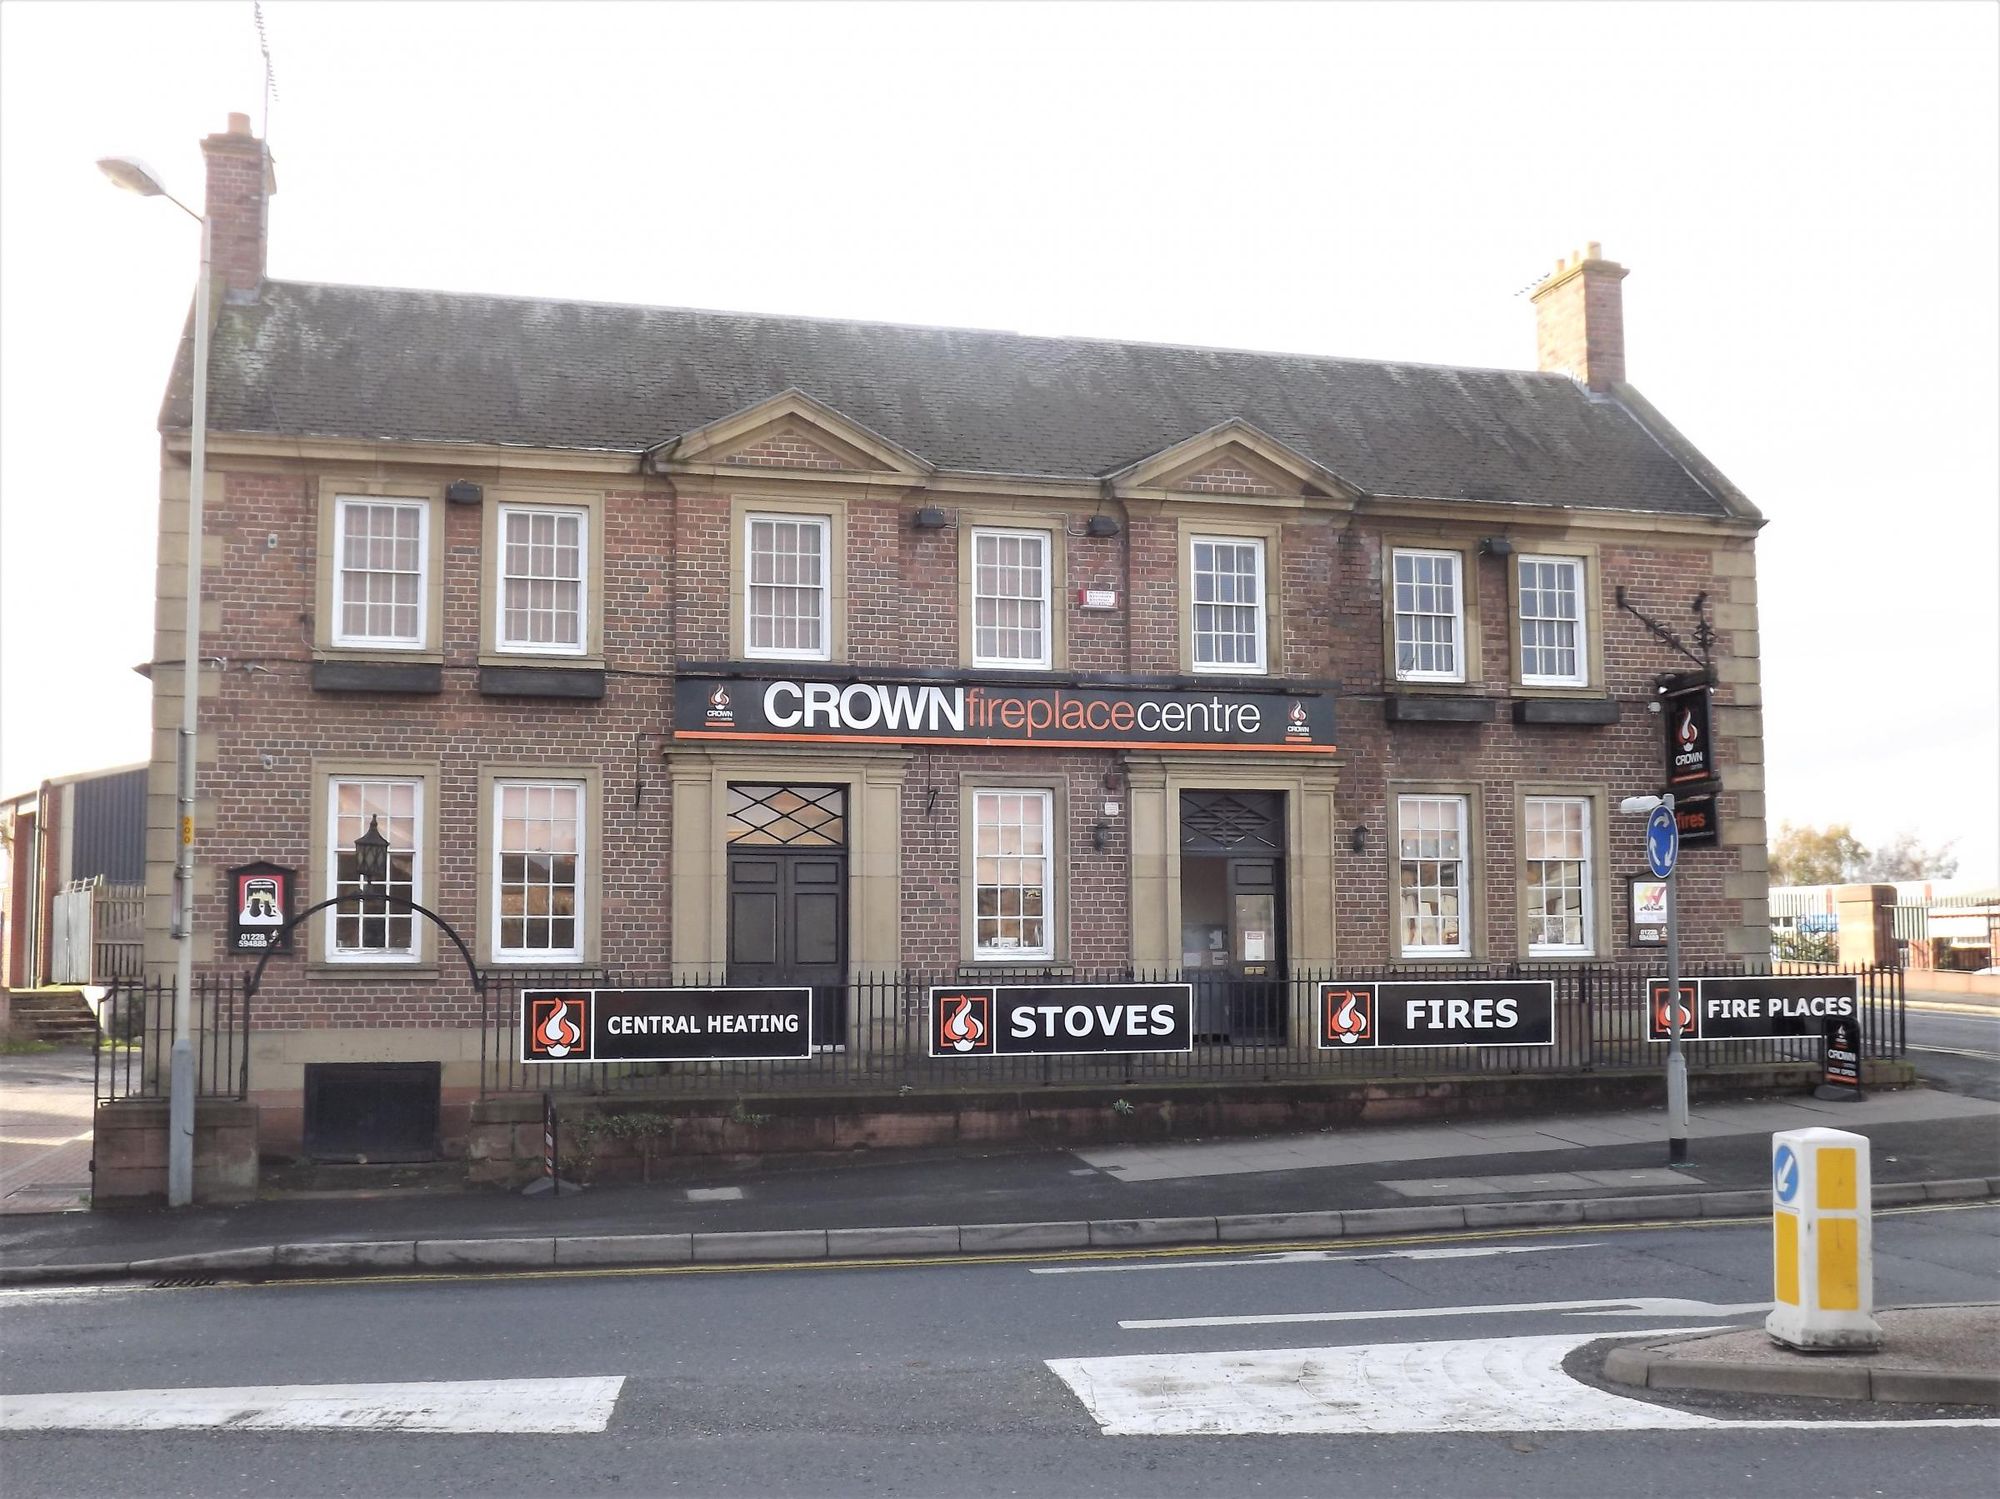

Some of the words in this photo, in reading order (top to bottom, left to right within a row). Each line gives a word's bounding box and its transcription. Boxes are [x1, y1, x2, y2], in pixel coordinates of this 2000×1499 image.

[1675, 752, 1703, 766] CROWN
[1676, 812, 1705, 830] fires
[240, 933, 266, 941] 01228
[1406, 998, 1519, 1029] FIRES
[1707, 999, 1761, 1019] FIRE
[1768, 996, 1853, 1017] PLACES
[607, 1016, 700, 1034] CENTRAL
[707, 1014, 799, 1034] HEATING
[1010, 1004, 1176, 1038] STOVES
[1827, 1049, 1857, 1062] CROWN
